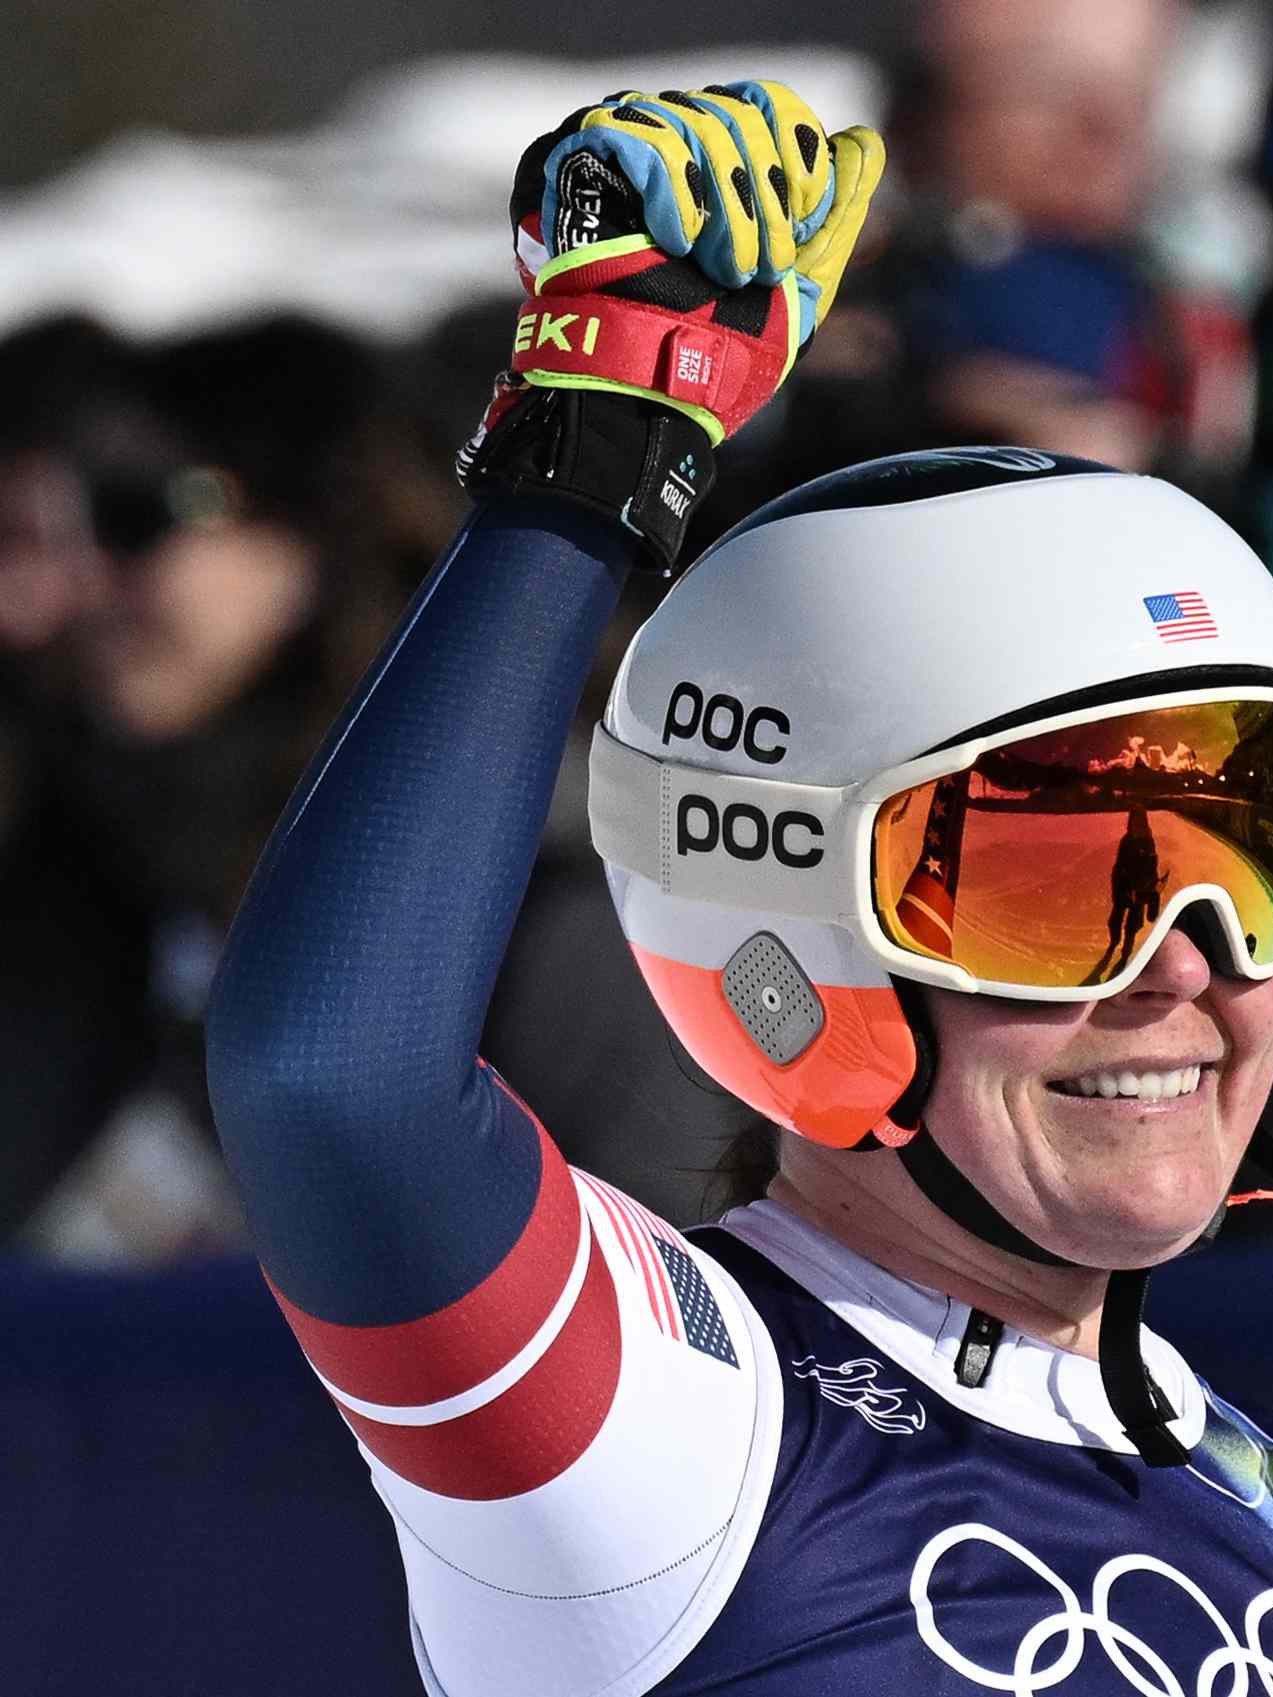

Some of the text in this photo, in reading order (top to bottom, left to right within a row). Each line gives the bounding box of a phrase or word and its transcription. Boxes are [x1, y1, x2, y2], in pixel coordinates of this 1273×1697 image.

[514, 312, 601, 356] EKI
[677, 345, 692, 380] ONE
[688, 348, 702, 384] SIZE
